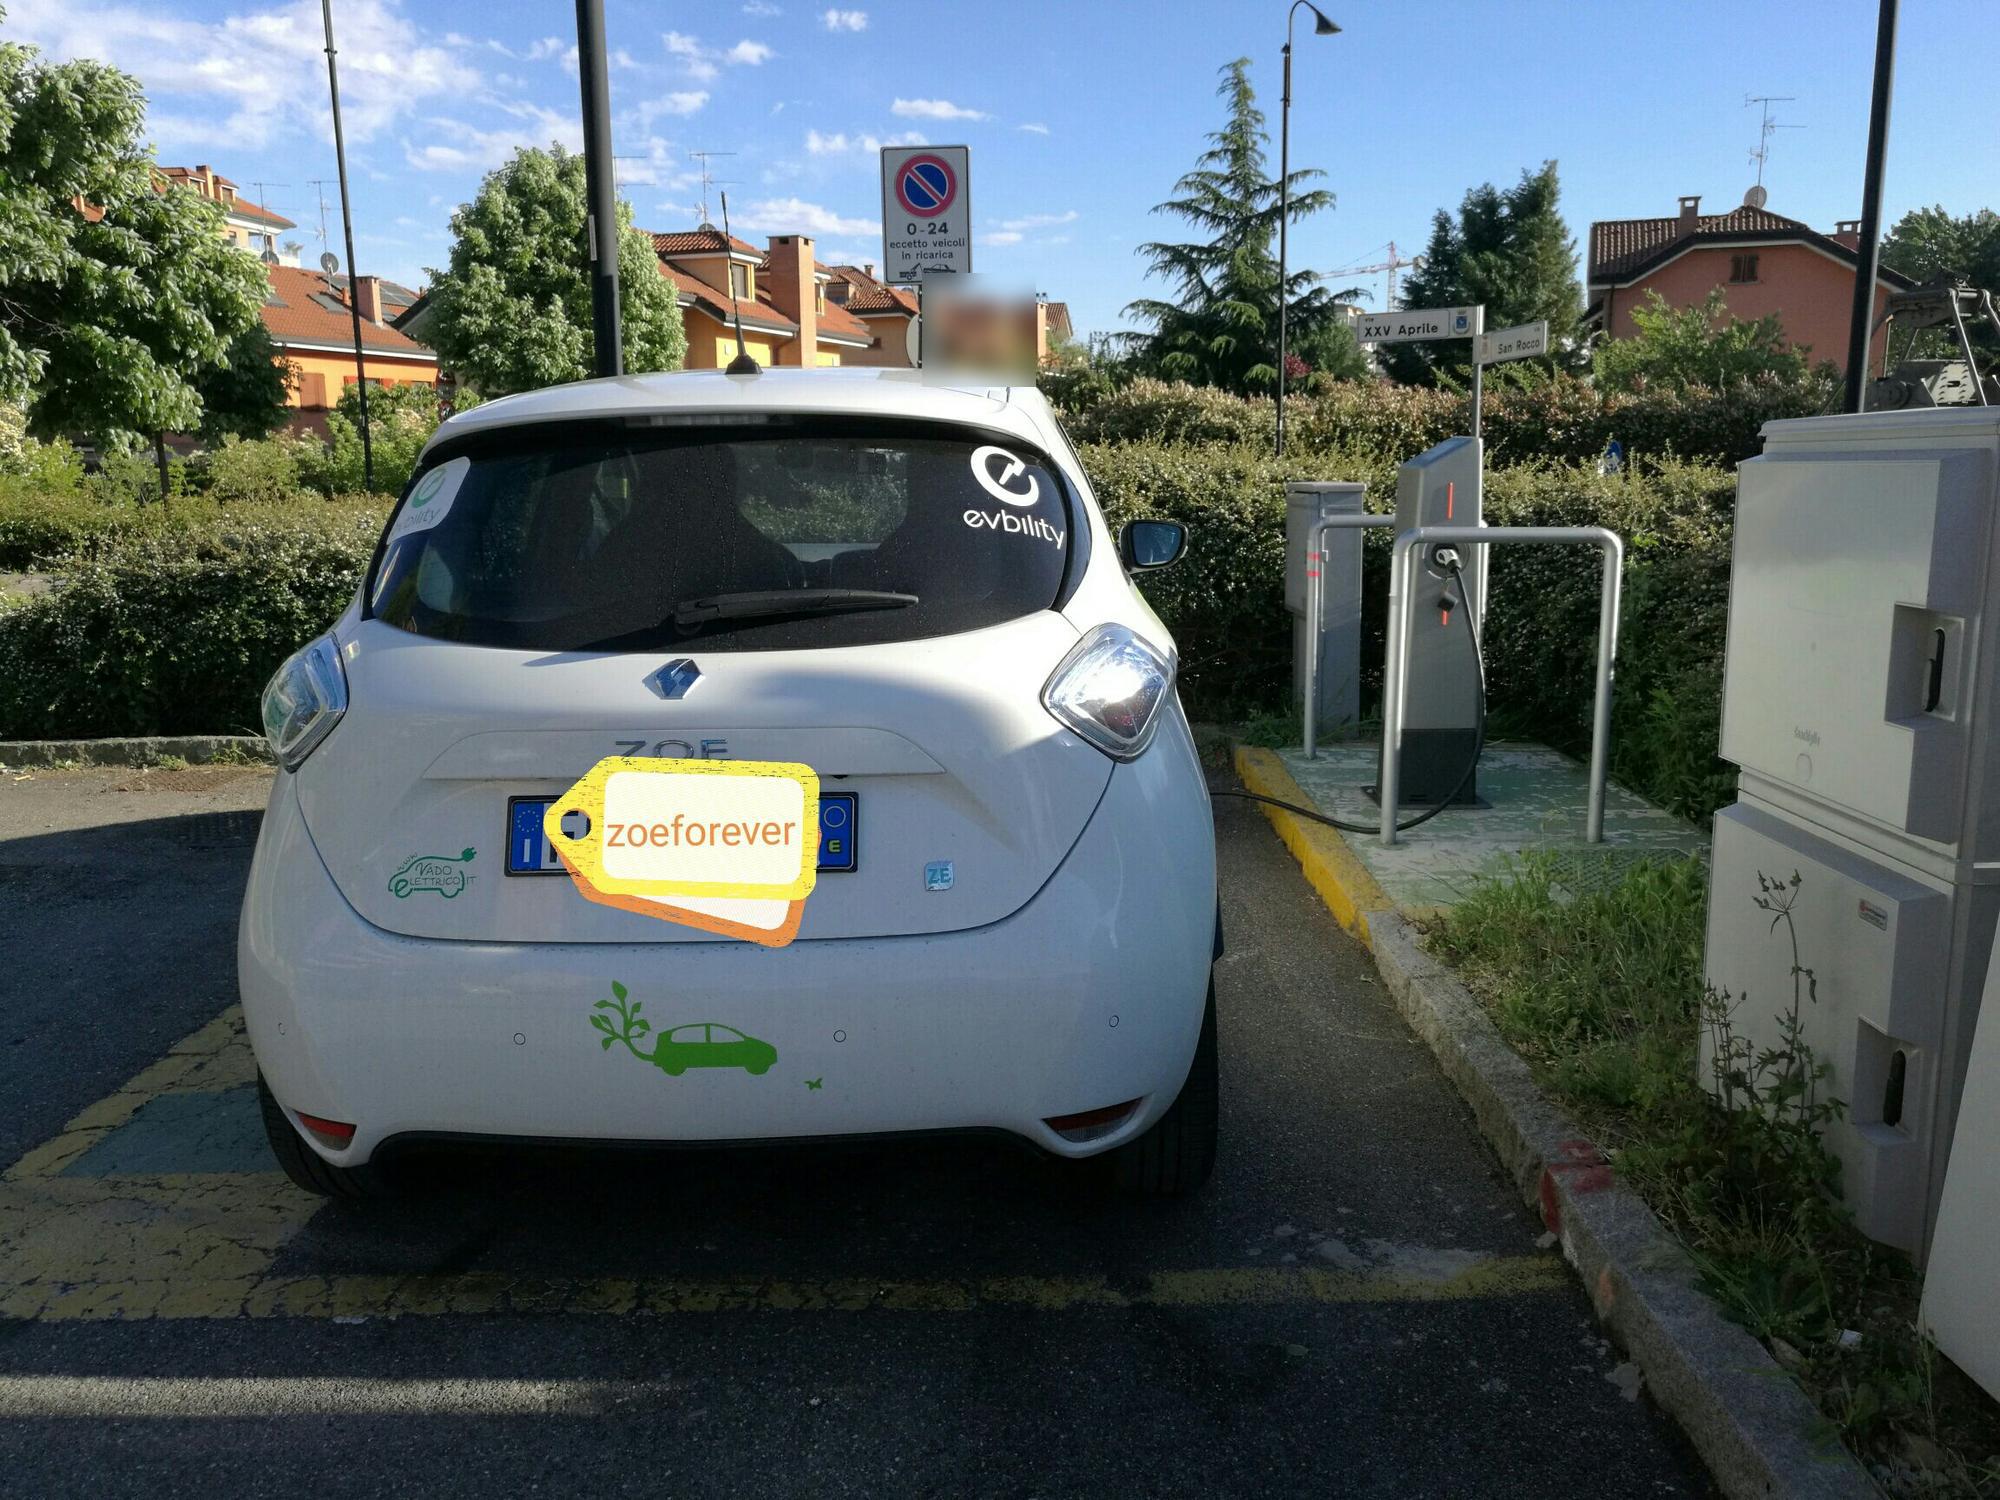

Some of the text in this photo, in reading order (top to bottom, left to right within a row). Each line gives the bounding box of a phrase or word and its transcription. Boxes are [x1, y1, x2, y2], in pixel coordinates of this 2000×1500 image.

[890, 237, 965, 249] eccetto veicoli
[902, 250, 954, 260] in ricarica
[1364, 323, 1438, 338] XXV Aprile
[1498, 339, 1540, 354] San Rocco
[963, 509, 1064, 550] evbility
[615, 739, 731, 759] ZOE
[415, 863, 452, 876] VADO
